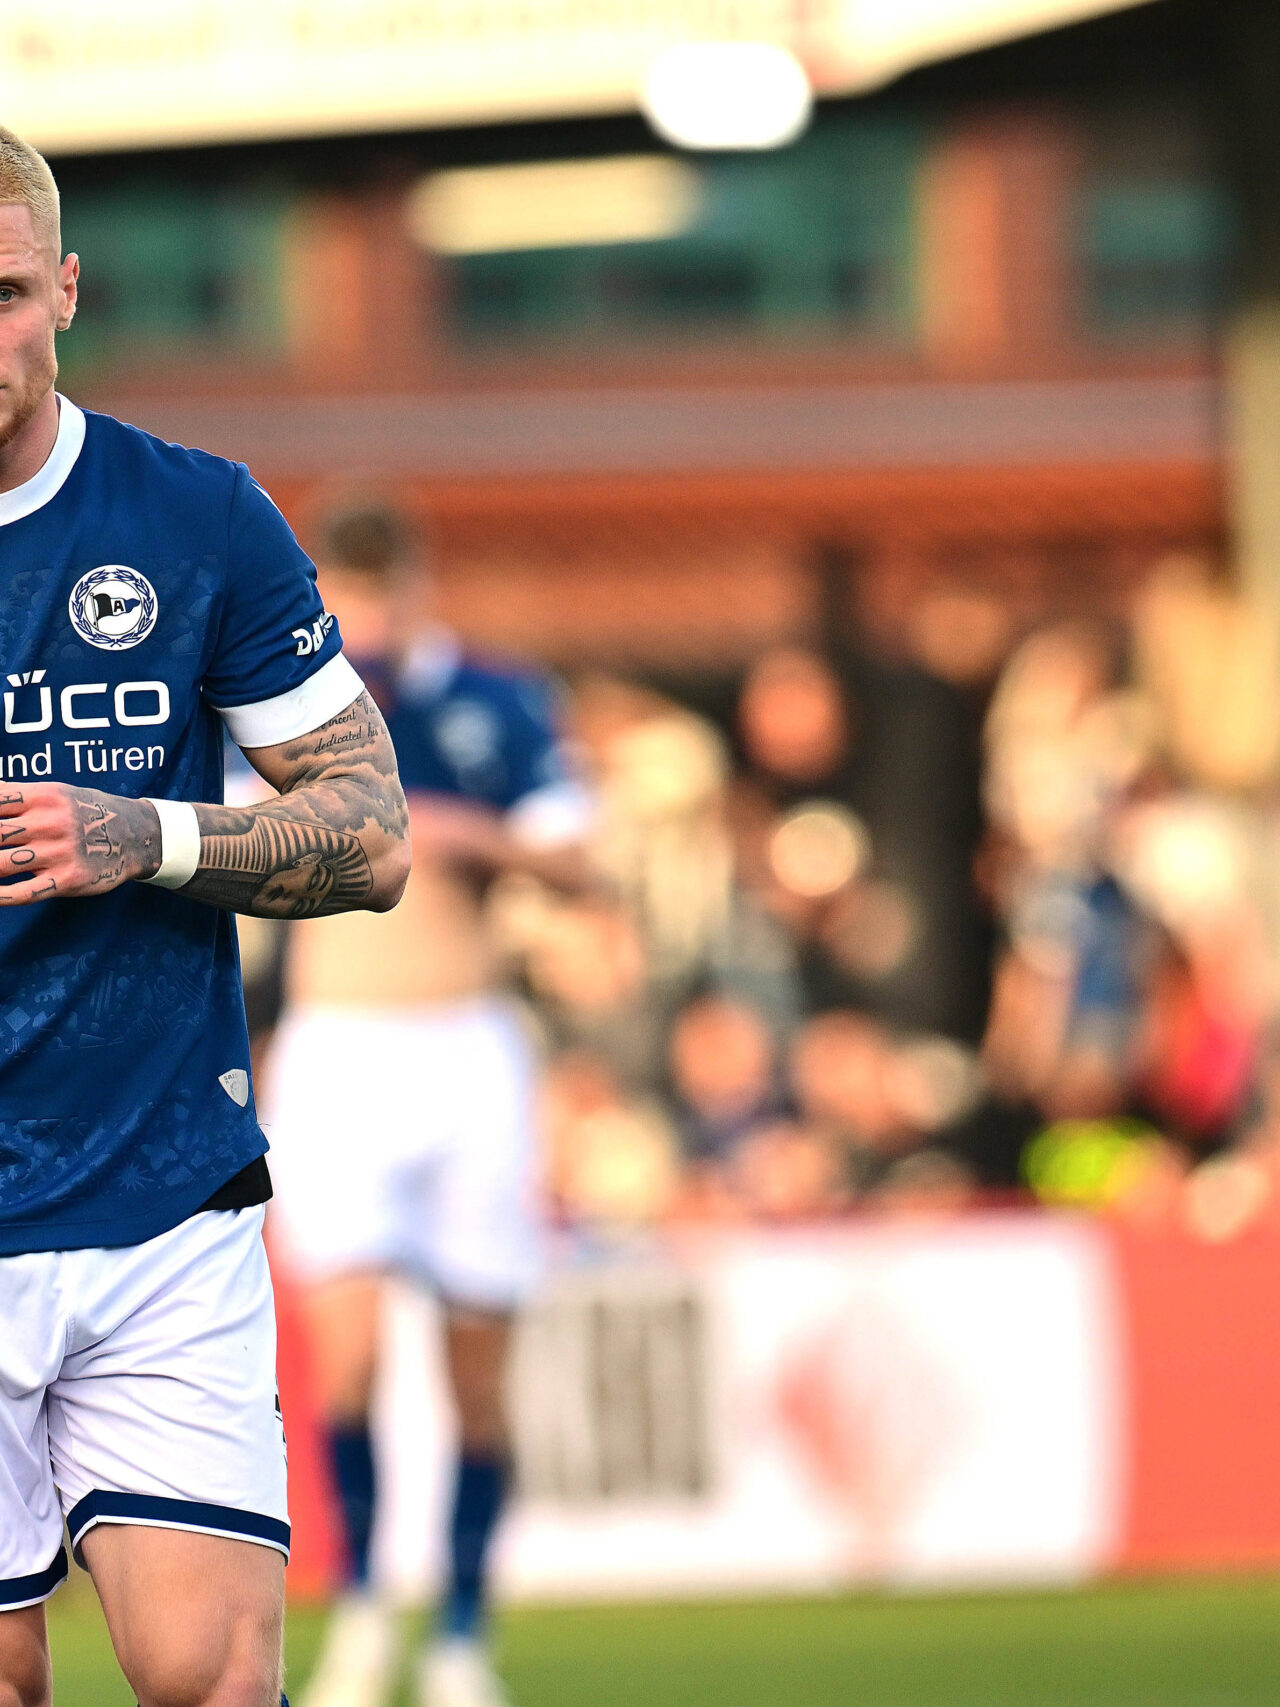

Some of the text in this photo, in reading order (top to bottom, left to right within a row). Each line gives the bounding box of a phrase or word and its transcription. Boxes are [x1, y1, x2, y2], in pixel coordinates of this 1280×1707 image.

[113, 600, 125, 613] A
[314, 725, 362, 754] dedicated
[64, 740, 165, 774] Türen
